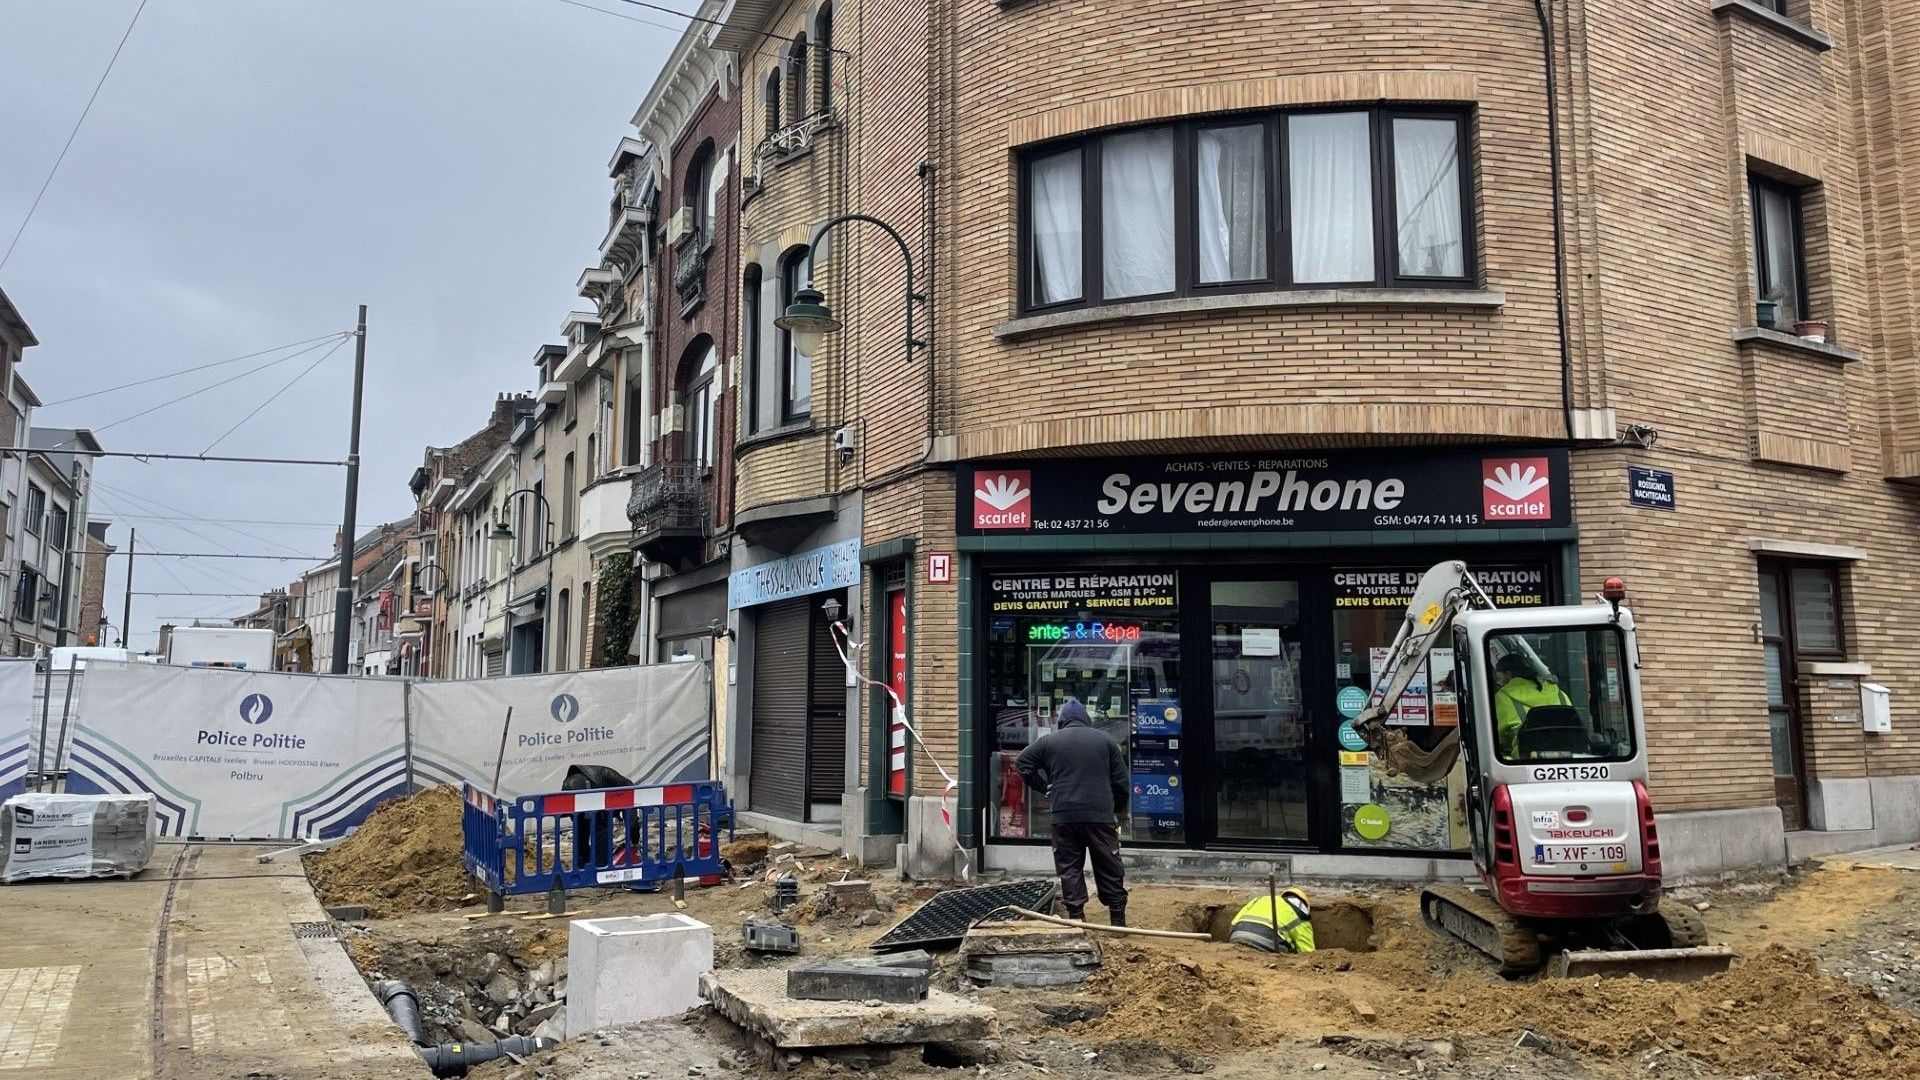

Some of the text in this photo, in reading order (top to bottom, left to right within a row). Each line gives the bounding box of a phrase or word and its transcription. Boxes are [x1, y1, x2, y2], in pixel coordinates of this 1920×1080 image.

[1165, 462, 1204, 472] ACHATS
[1212, 461, 1250, 471] VENTES
[1258, 459, 1328, 470] REPARATIONS
[1638, 481, 1666, 491] ROSSIGNOL
[1097, 471, 1405, 515] SevenPhone
[1635, 489, 1671, 502] NACHTEGAALS
[1490, 502, 1545, 516] scarlet
[978, 511, 1026, 525] scarlet
[1034, 519, 1109, 529] Tel: 02 437 21 56
[1198, 518, 1294, 527] neder@sevenphone.be
[1374, 514, 1478, 525] GSM: 0474 74 14 15
[933, 559, 946, 577] H
[755, 554, 824, 599] THESSALONIQUE
[992, 574, 1173, 591] CENTRE DE RÉPARATION
[1334, 572, 1400, 585] CENTRE
[1012, 591, 1048, 599] TOUTES
[1051, 590, 1096, 599] MARQUES
[1111, 589, 1132, 597] GSM
[1143, 588, 1156, 596] PC
[1357, 587, 1398, 595] TOUTES
[1496, 585, 1504, 593] &
[1507, 585, 1521, 593] PC
[993, 600, 1069, 611] DEVIS GRATUIT
[1086, 597, 1173, 608] SERVICE RAPIDE
[1336, 597, 1413, 606] DEVIS GRATU
[1496, 595, 1541, 604] RAPIDE
[1075, 623, 1088, 640] &
[197, 730, 306, 749] Police Politie
[518, 726, 614, 747] Police Politie
[153, 753, 188, 763] Bruxelles
[188, 755, 222, 764] CAPITALE
[224, 756, 247, 765] Ixelles
[279, 759, 318, 767] HOOFDSTAD
[230, 770, 263, 781] Polbru
[1534, 766, 1609, 781] G2RT520
[1533, 815, 1552, 823] Infra
[1546, 829, 1614, 839] TAKEUCHI
